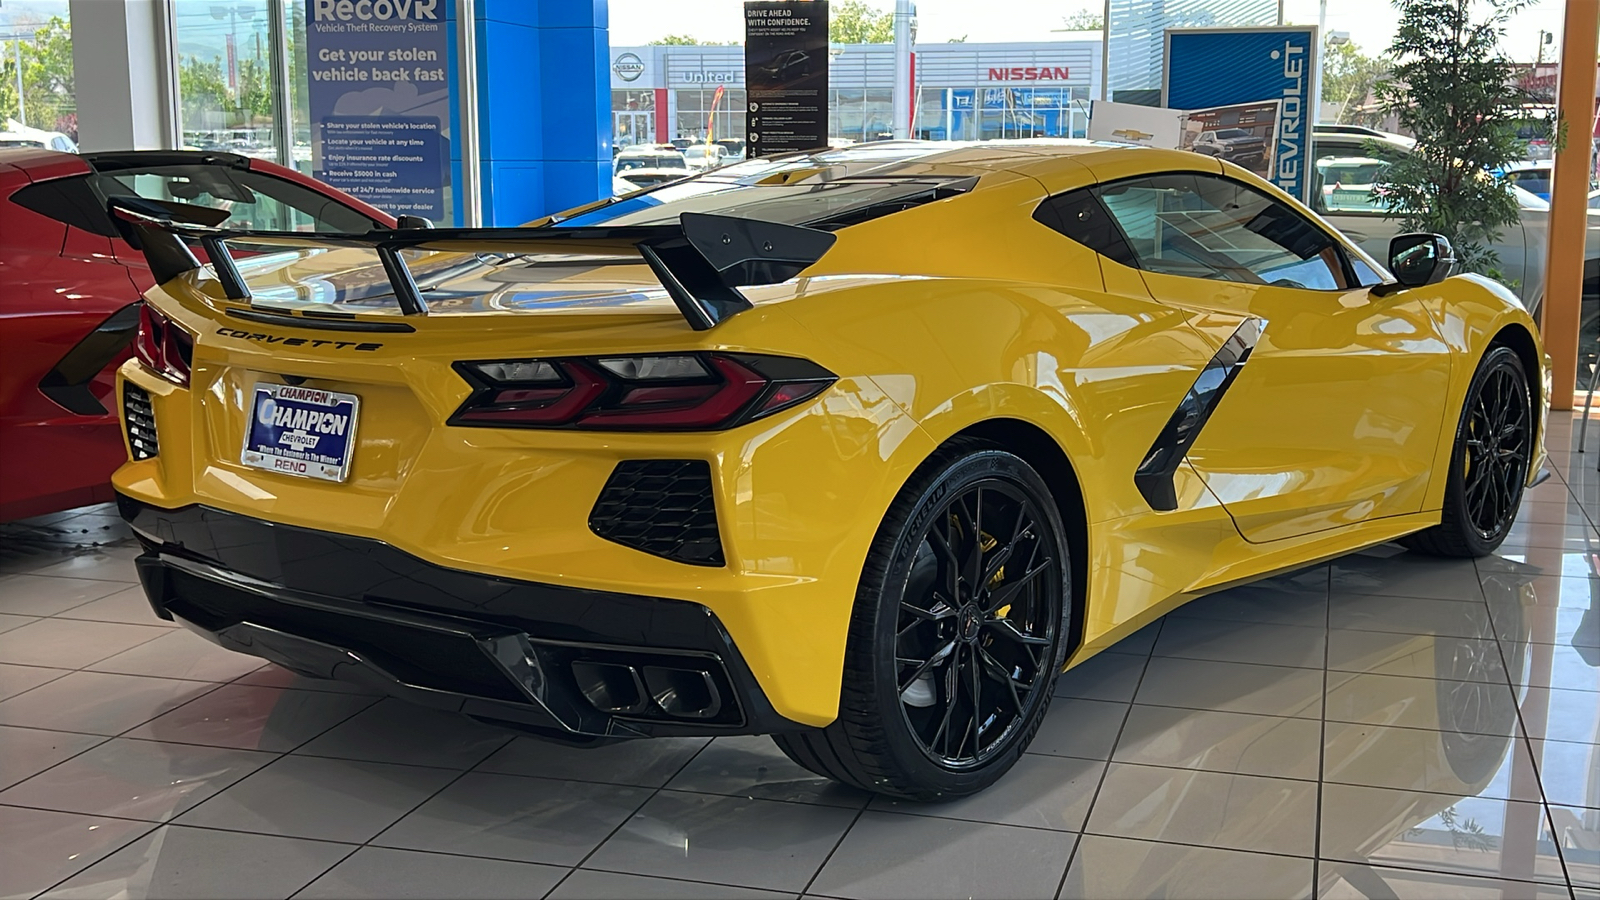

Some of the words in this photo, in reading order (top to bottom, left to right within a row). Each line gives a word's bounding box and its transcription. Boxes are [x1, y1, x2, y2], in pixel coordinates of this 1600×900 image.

[315, 23, 345, 32] Vehicle
[346, 23, 368, 32] Theft
[369, 23, 406, 33] Recovery
[407, 23, 438, 33] System
[767, 18, 811, 26] CONFIDENCE.
[318, 48, 346, 61] Get
[349, 50, 384, 64] your
[388, 47, 437, 61] stolen
[312, 67, 368, 81] vehicle
[372, 67, 410, 81] back
[414, 67, 444, 81] fast
[682, 71, 734, 83] United
[988, 67, 1069, 80] NISSAN
[1278, 40, 1304, 198] HEVROLET
[328, 154, 345, 162] Enjoy
[360, 186, 374, 194] 24/7
[412, 187, 435, 195] service
[216, 327, 383, 351] CORVETTE
[280, 387, 328, 404] CHAMPION
[259, 398, 348, 436] CHAMPION
[282, 433, 316, 446] CHEVROLET
[274, 447, 283, 456] The
[283, 448, 305, 459] Customer
[311, 453, 319, 462] The
[275, 459, 307, 473] RENO
[901, 486, 945, 558] MICHELIN
